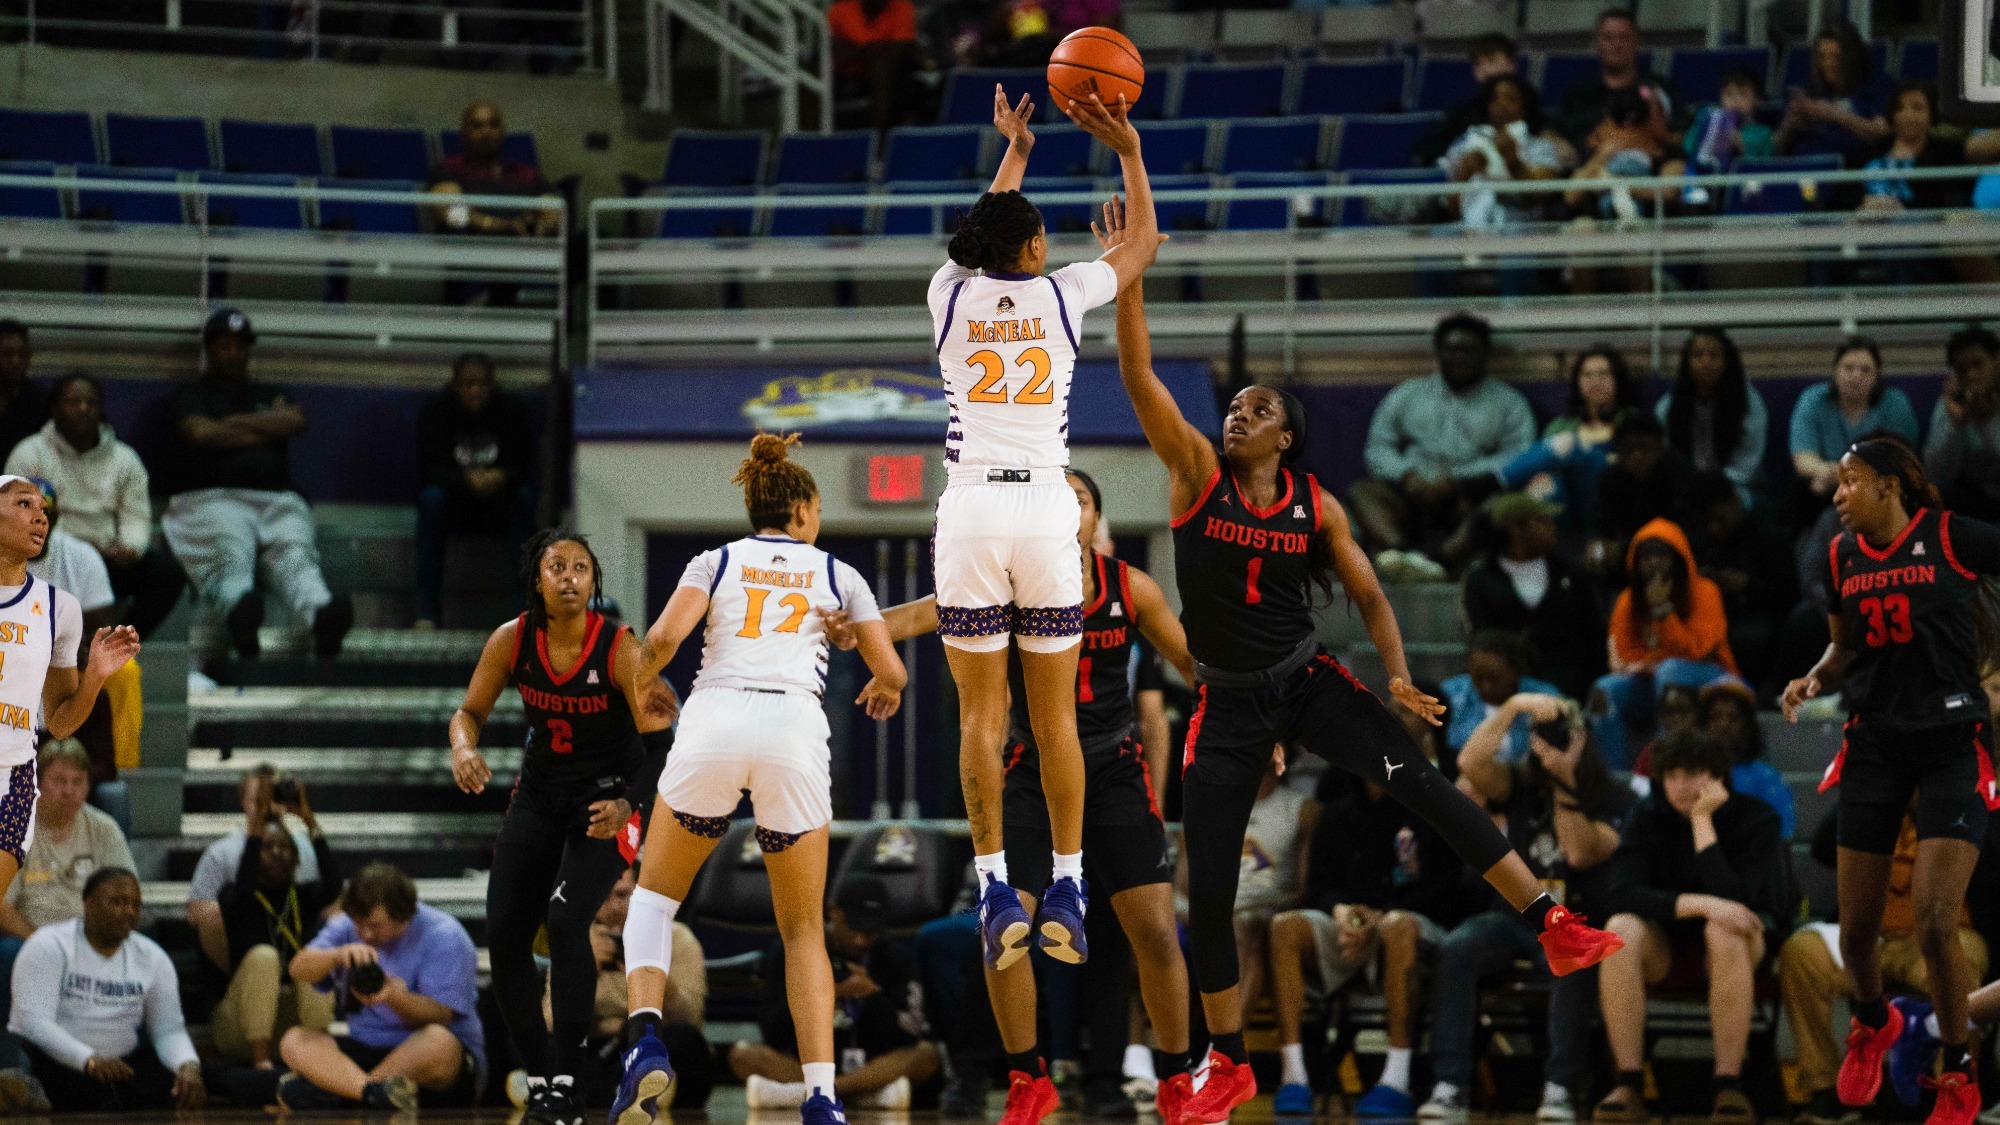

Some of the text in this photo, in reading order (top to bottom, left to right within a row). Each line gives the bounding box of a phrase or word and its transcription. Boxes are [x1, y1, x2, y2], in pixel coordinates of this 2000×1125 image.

[967, 318, 1046, 344] McNEAL
[965, 347, 1054, 404] 22
[1204, 516, 1309, 554] HOUSTON
[739, 565, 816, 589] MOSELEY
[1246, 557, 1263, 604] 1
[1841, 564, 1935, 599] HOUSTON
[735, 587, 810, 639] 12
[1859, 593, 1913, 647] 33
[1081, 626, 1127, 649] TON
[519, 682, 608, 714] HOUSTON
[546, 718, 573, 754] 2
